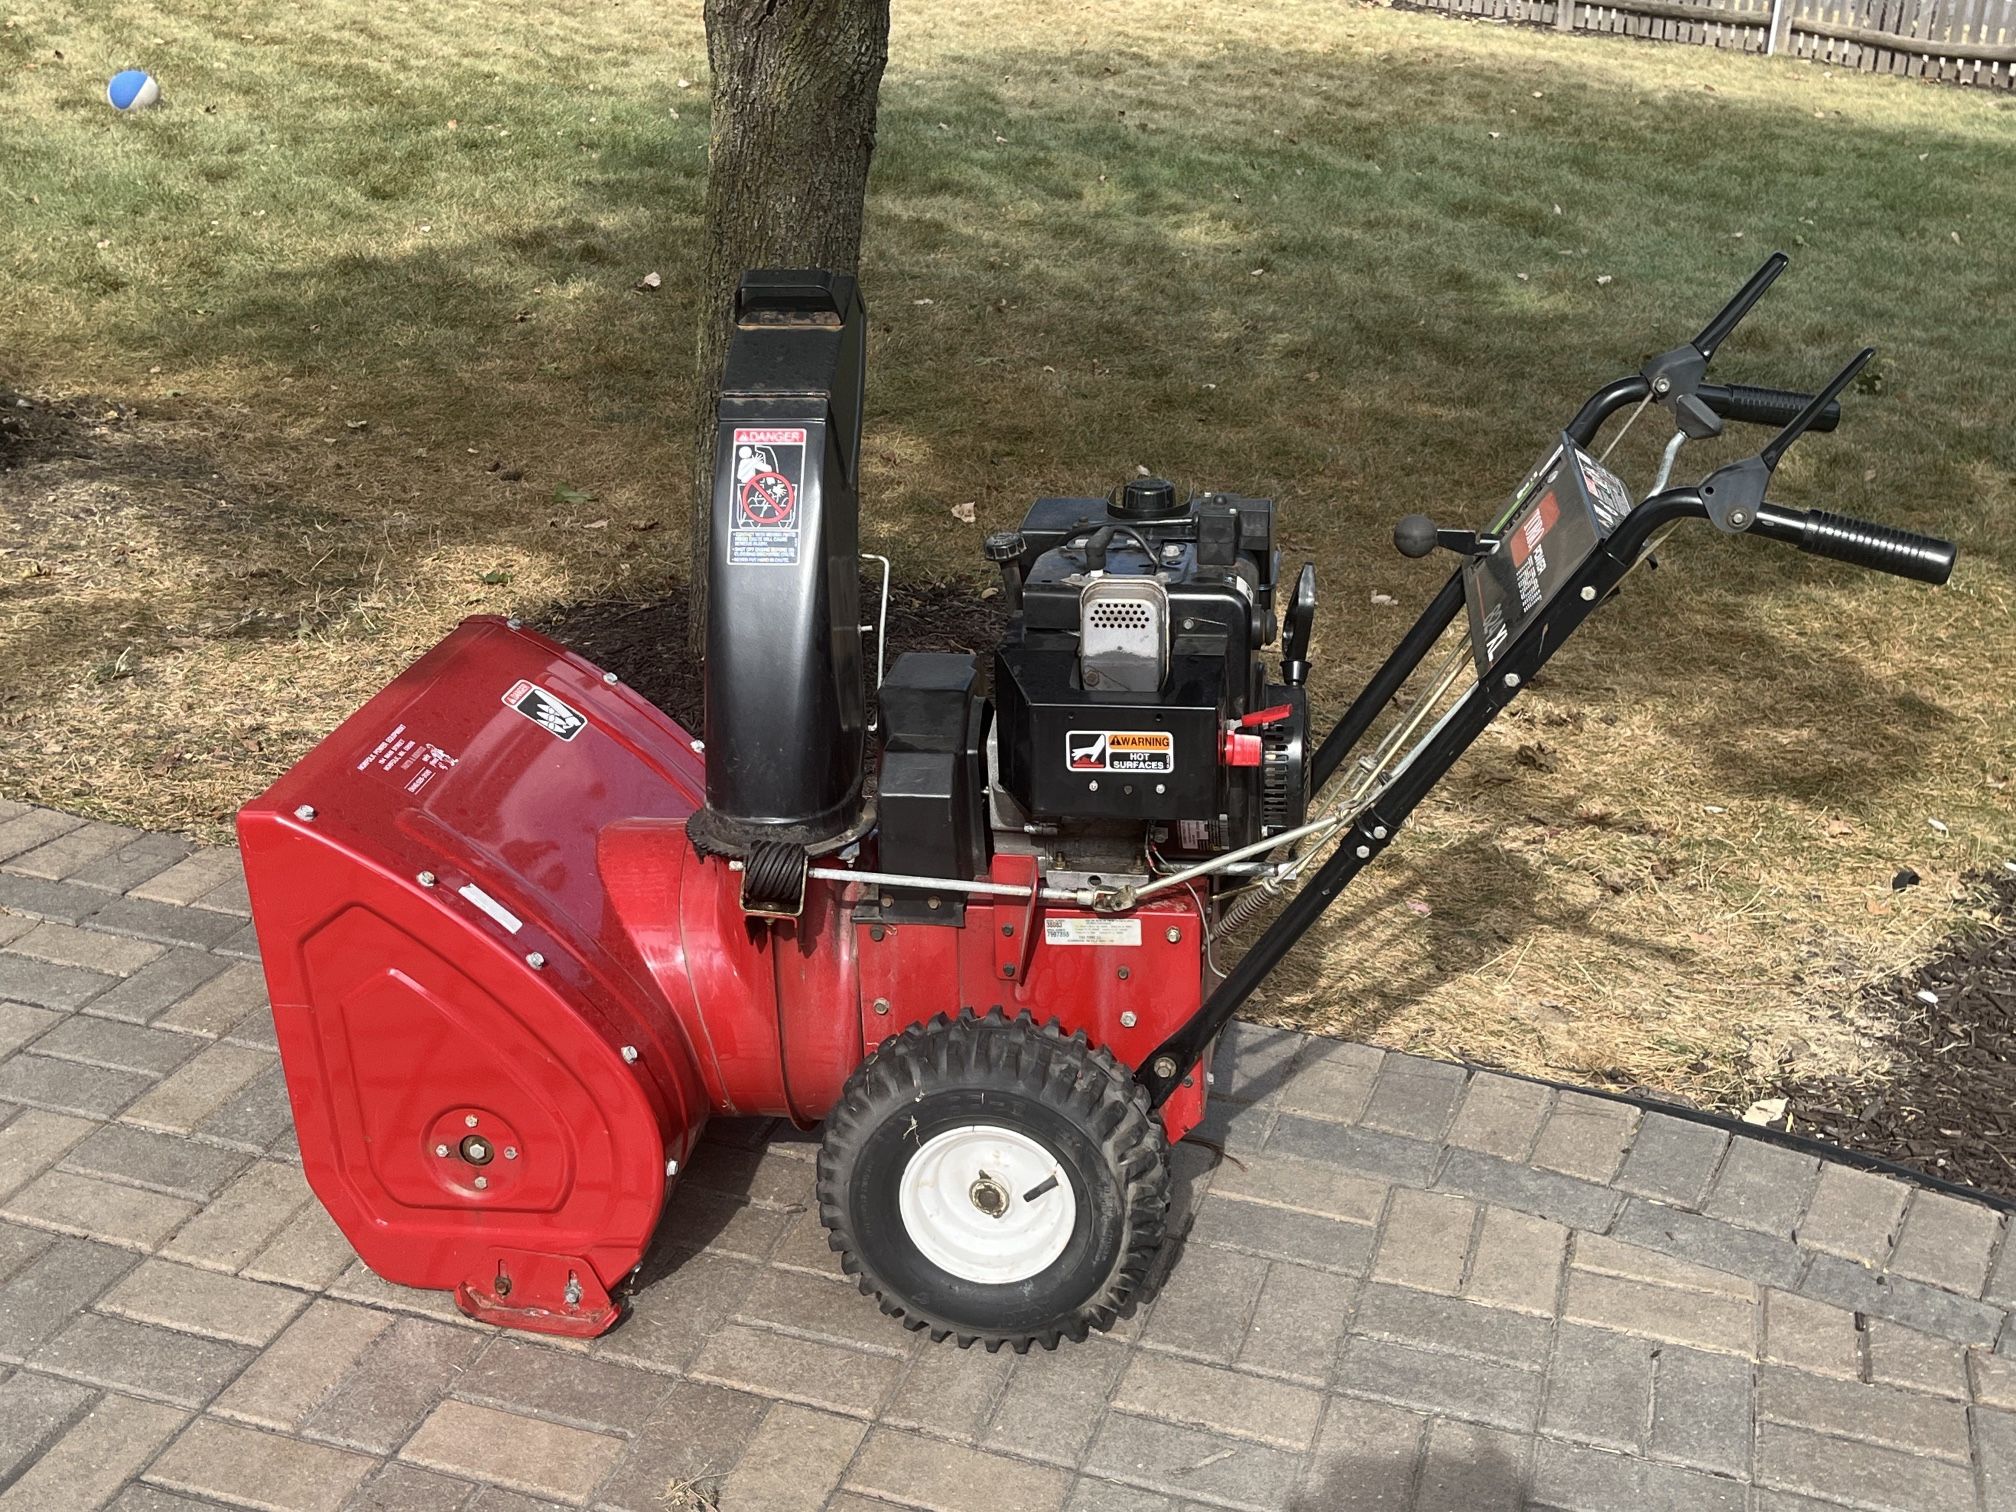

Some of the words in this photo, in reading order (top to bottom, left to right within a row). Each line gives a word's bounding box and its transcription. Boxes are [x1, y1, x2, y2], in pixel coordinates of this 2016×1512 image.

[750, 431, 800, 442] DANGER
[1523, 508, 1545, 552] TORO
[1533, 543, 1547, 576] POWER
[1121, 736, 1169, 747] WARNING
[1130, 753, 1150, 761] HOT
[1113, 761, 1164, 769] SURFACES
